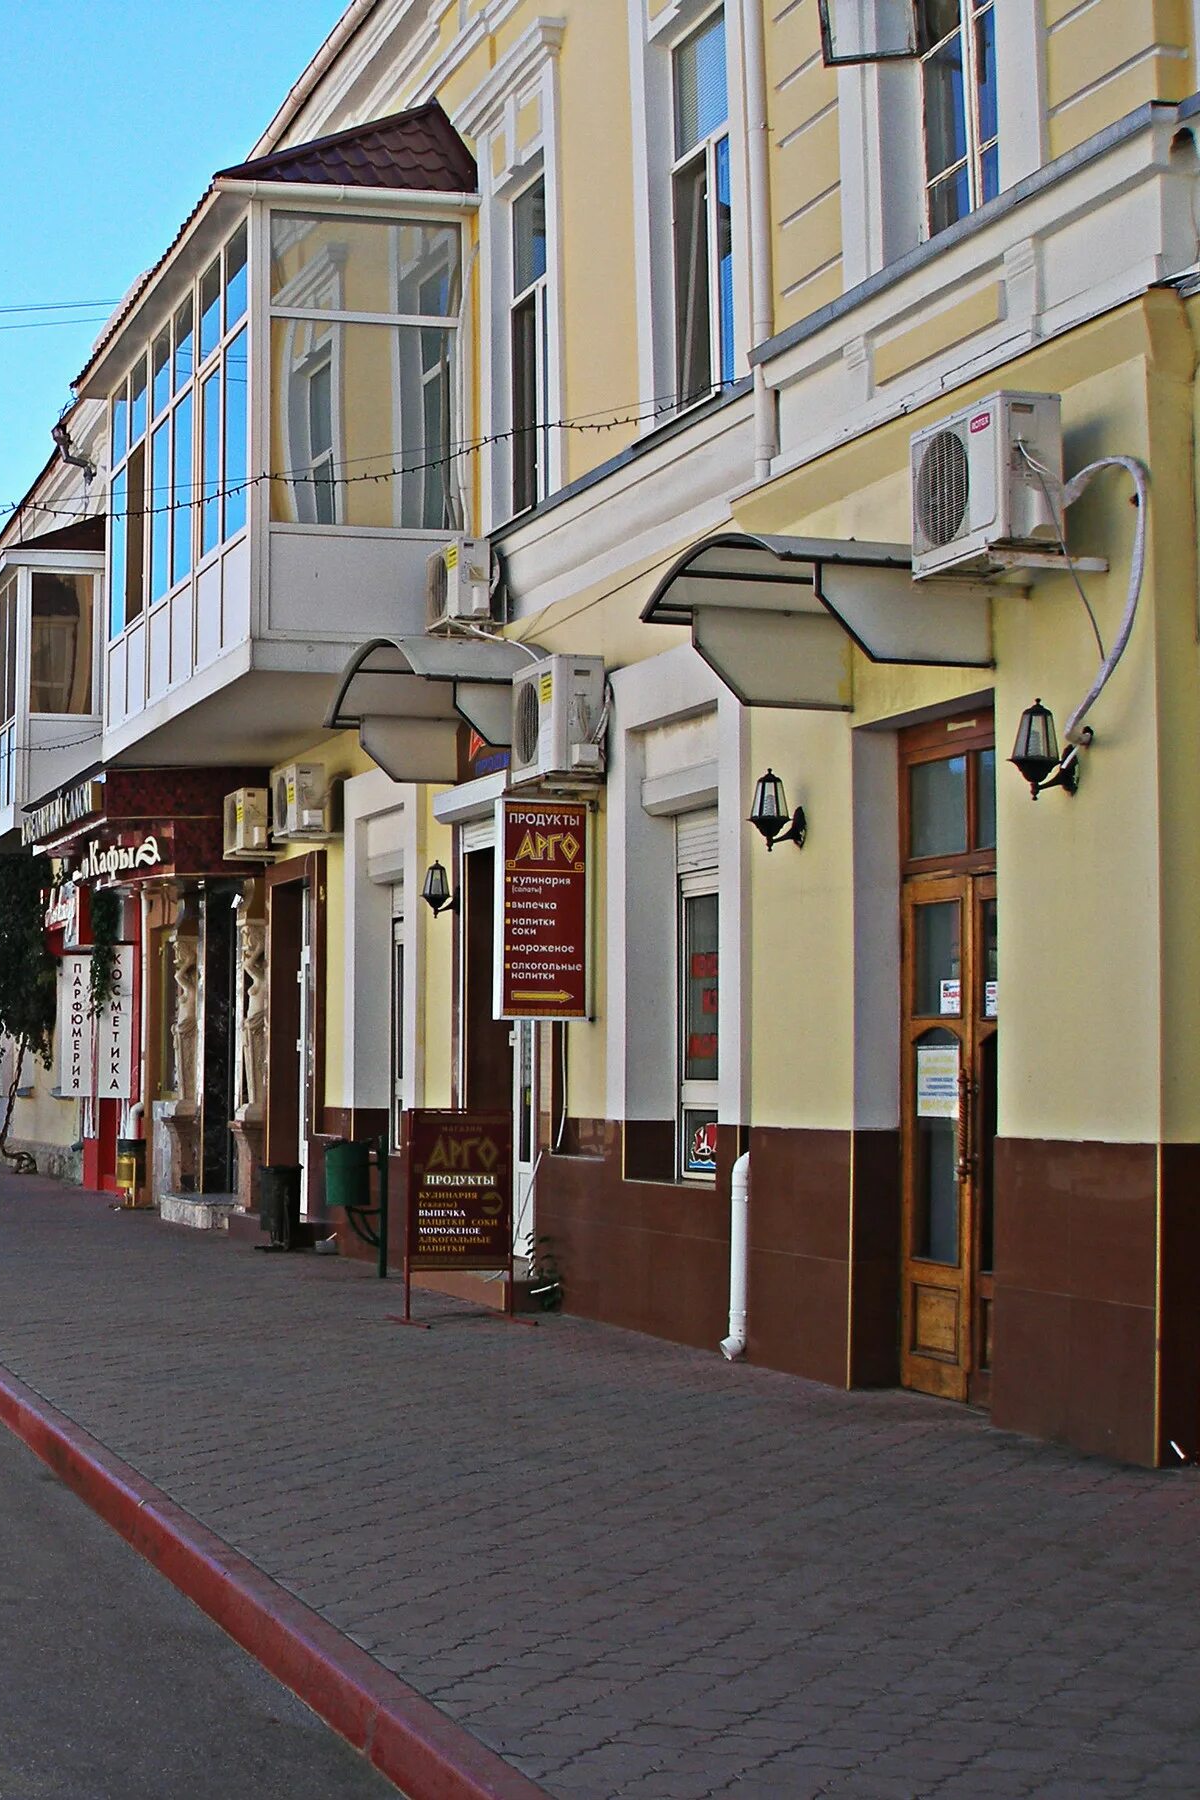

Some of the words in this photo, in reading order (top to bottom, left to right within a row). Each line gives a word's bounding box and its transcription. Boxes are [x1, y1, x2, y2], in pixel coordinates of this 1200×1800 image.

[509, 813, 580, 826] ПРОДУКТЫ
[515, 829, 580, 863] АРГО
[512, 876, 571, 887] кулинария
[512, 886, 542, 894] (салаты)
[511, 901, 557, 910] выпечка
[511, 918, 556, 926] напитки
[511, 928, 537, 936] соки
[511, 945, 575, 955] мороженое
[511, 962, 582, 972] алкогольные
[511, 971, 555, 980] напитки
[71, 963, 83, 1089] ПАРФЮМЕРИЯ
[110, 953, 122, 1090] КОСМЕТИКА
[427, 1134, 498, 1170] АРГО
[426, 1175, 494, 1186] ПРОДУКТЫ
[418, 1209, 466, 1217] ВЫПЕЧКА
[418, 1218, 465, 1226] НАПИТКИ
[471, 1218, 497, 1226] СОКИ
[419, 1227, 481, 1235] МОРОЖЕНОЕ
[418, 1236, 492, 1244] АЛКОГОЛЬНЫЕ
